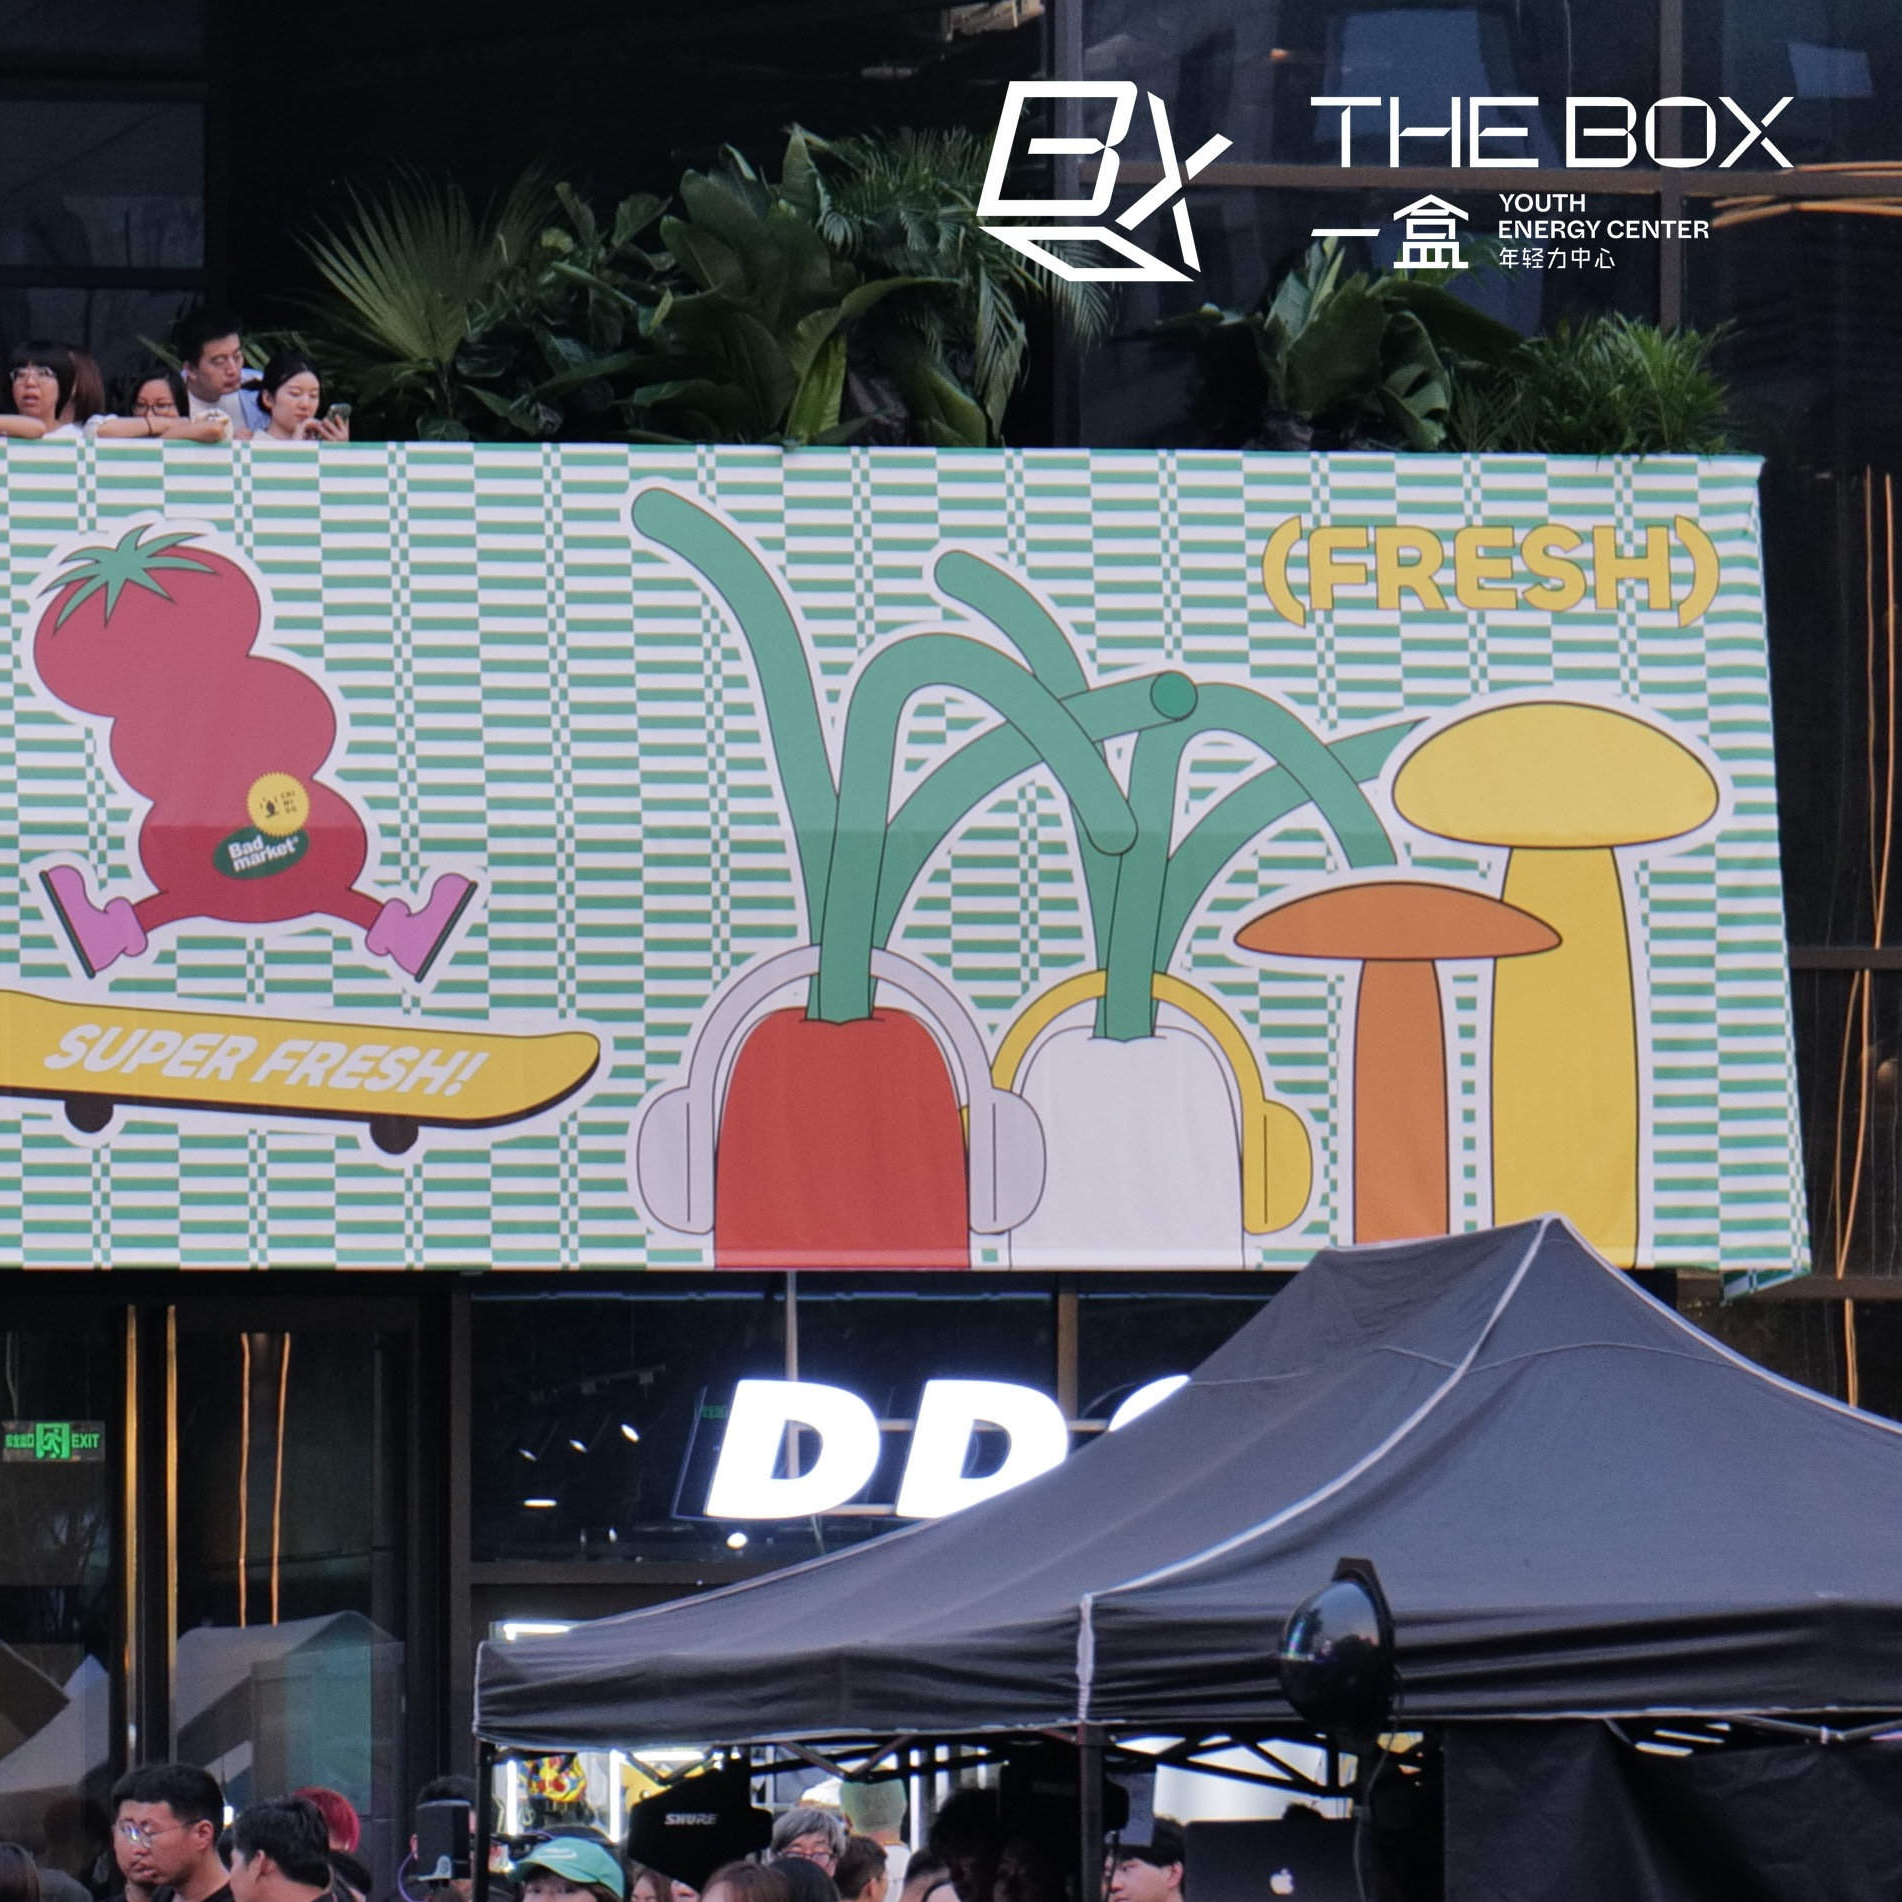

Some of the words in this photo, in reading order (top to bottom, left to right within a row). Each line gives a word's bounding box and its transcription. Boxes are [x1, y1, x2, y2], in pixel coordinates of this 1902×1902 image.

[1262, 514, 1721, 628] (FRESH)
[228, 834, 265, 861] Bad
[43, 1023, 245, 1081] SUPER
[249, 1038, 489, 1098] FRESH!
[71, 1433, 100, 1448] EXIT
[705, 1374, 1191, 1520] DD
